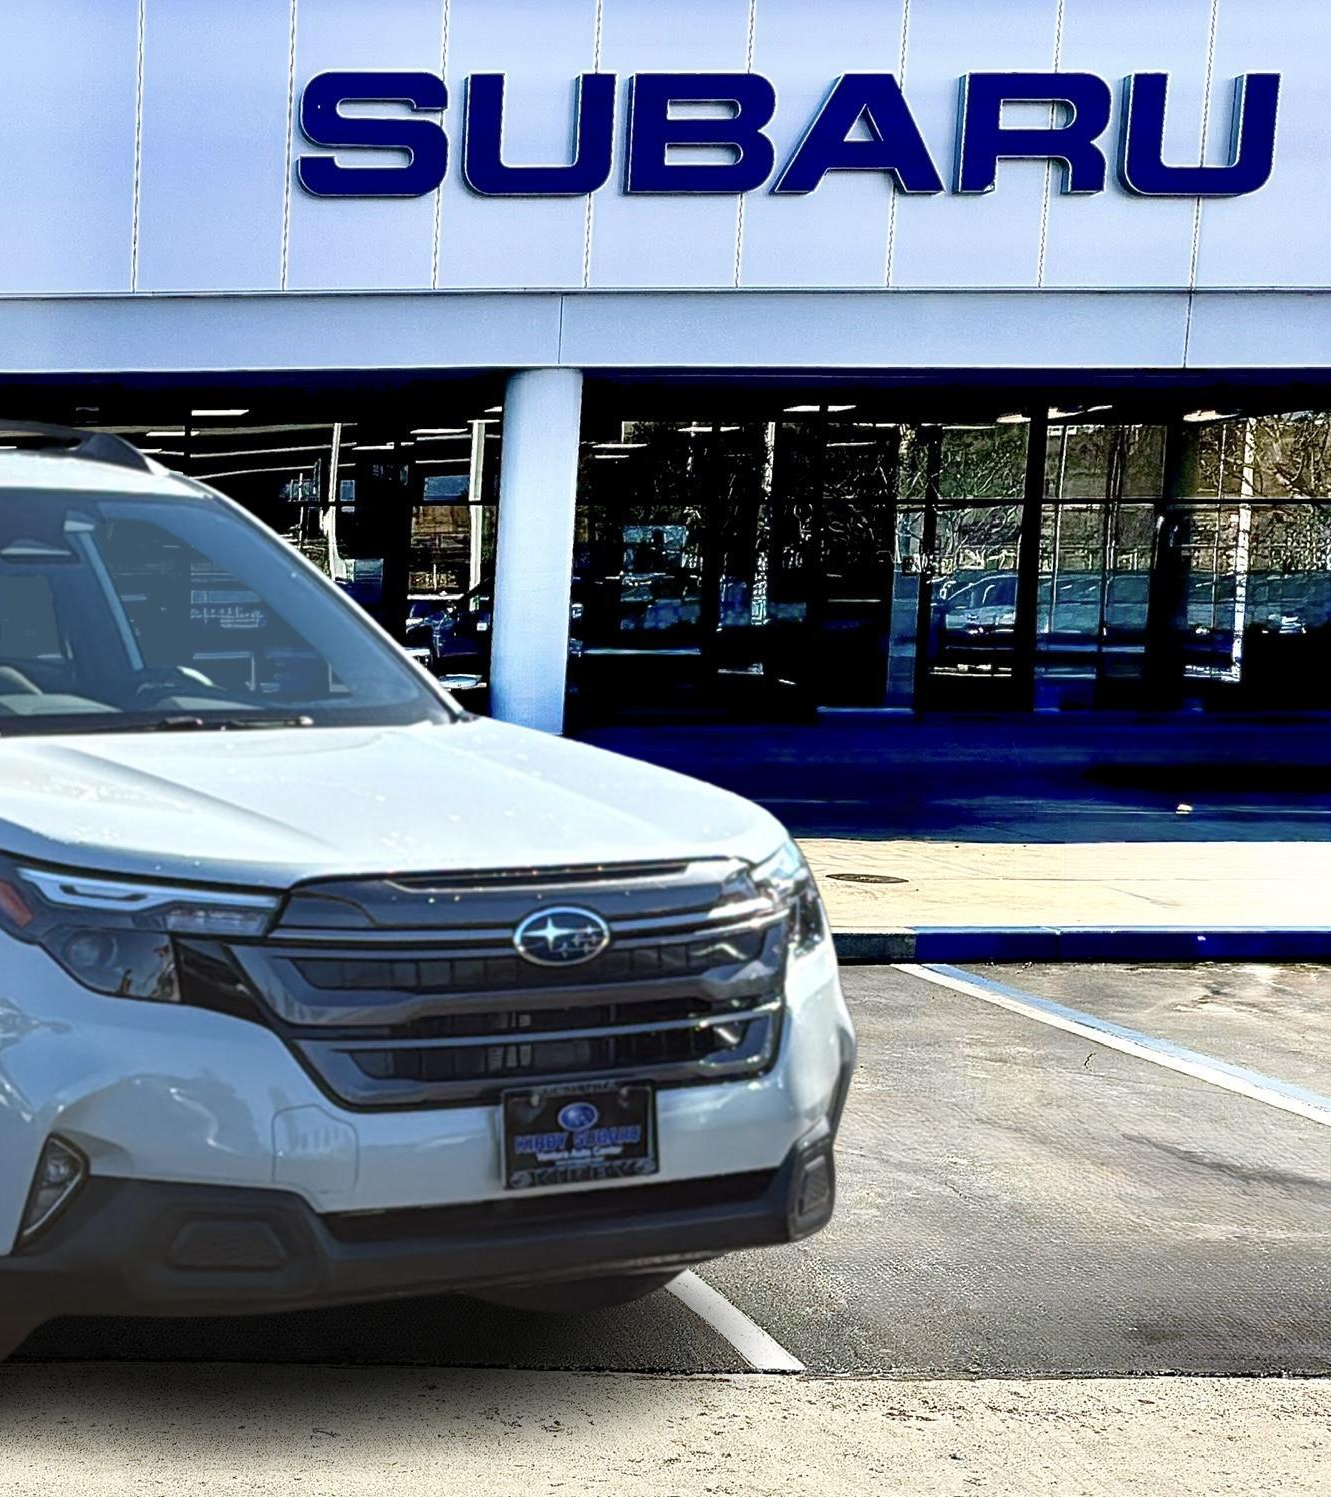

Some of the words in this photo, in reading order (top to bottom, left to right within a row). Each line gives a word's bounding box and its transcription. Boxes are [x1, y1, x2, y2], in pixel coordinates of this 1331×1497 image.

[296, 70, 1283, 199] SUBARU
[515, 1133, 568, 1154] KIRBY
[573, 1125, 642, 1148] SUBARU
